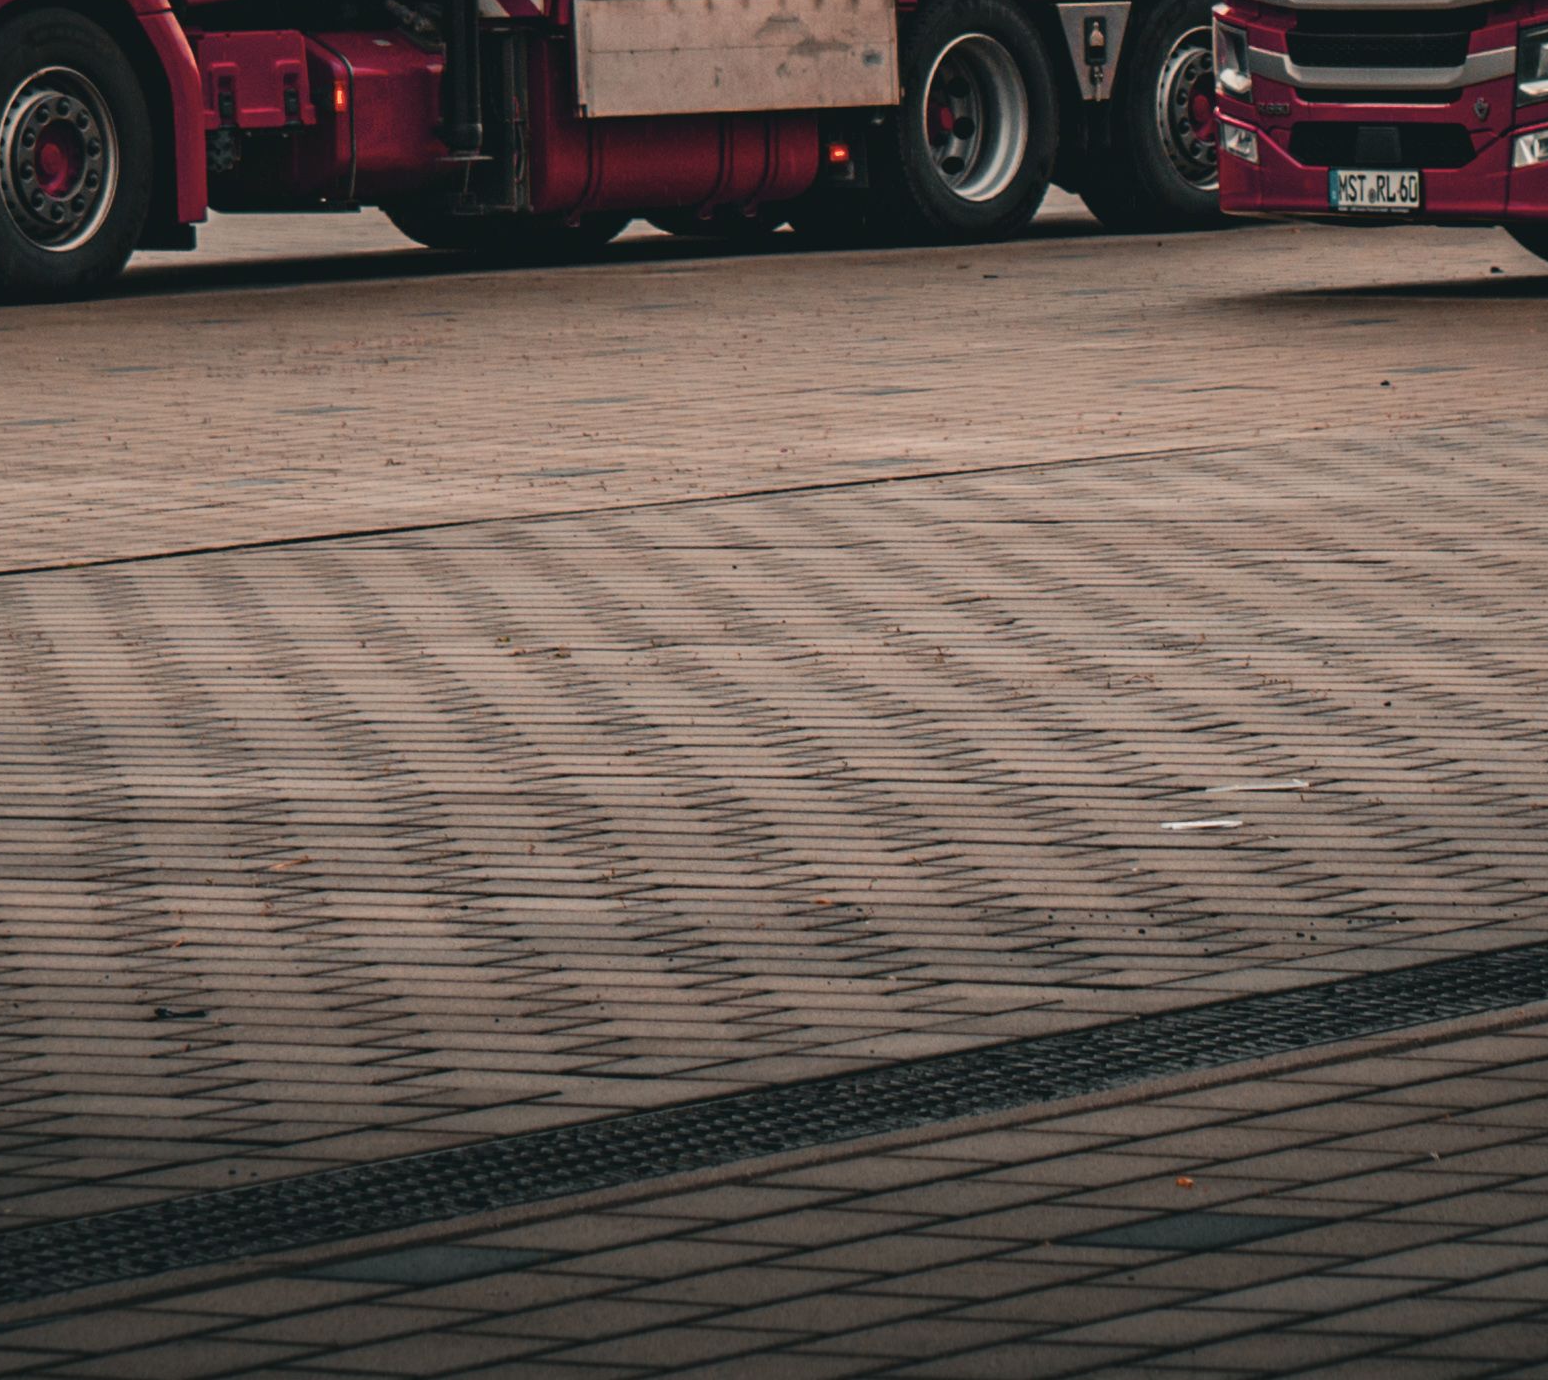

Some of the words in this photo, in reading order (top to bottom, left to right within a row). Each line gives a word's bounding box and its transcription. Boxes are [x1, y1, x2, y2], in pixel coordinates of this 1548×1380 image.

[1338, 174, 1366, 203] MST
[1376, 174, 1396, 203] RL
[1400, 174, 1419, 203] 60
